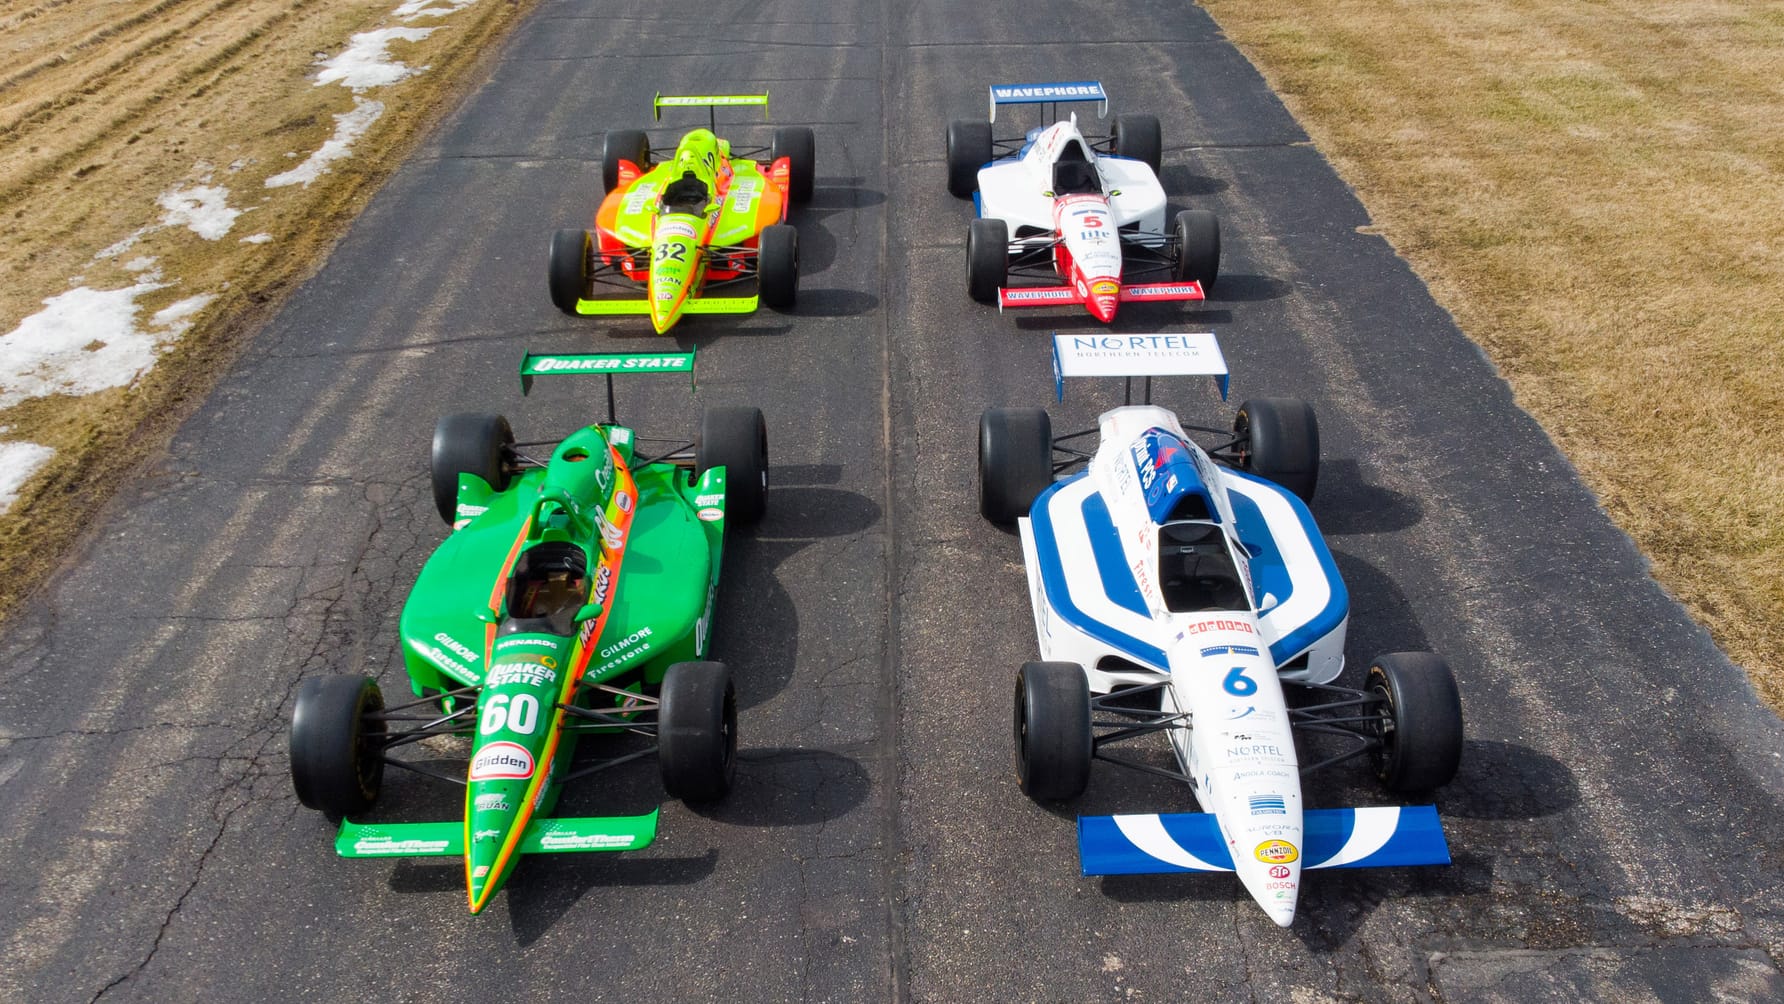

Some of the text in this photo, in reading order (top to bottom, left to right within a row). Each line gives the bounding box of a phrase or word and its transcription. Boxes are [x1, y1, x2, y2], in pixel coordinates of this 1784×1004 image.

[996, 86, 1100, 97] WAVEPHORE
[1084, 216, 1103, 228] 5
[656, 243, 687, 262] 32
[1008, 291, 1071, 300] WAVEPHORE
[1130, 286, 1195, 296] WAVEPHORE
[1074, 336, 1197, 350] NORTEL
[533, 357, 686, 372] QUAKER STATE
[434, 632, 480, 663] GILMORE
[600, 626, 653, 658] GILMORE
[587, 642, 651, 679] Firestone
[485, 663, 556, 686] QUAKER
[488, 672, 543, 689] STATE
[1223, 667, 1258, 697] 6
[480, 693, 539, 736] 60
[1227, 745, 1285, 757] NORTEL
[475, 754, 528, 770] Glidden
[1260, 847, 1293, 857] PENNZOIL
[1271, 866, 1290, 878] STP
[1266, 881, 1296, 890] BOSCH
